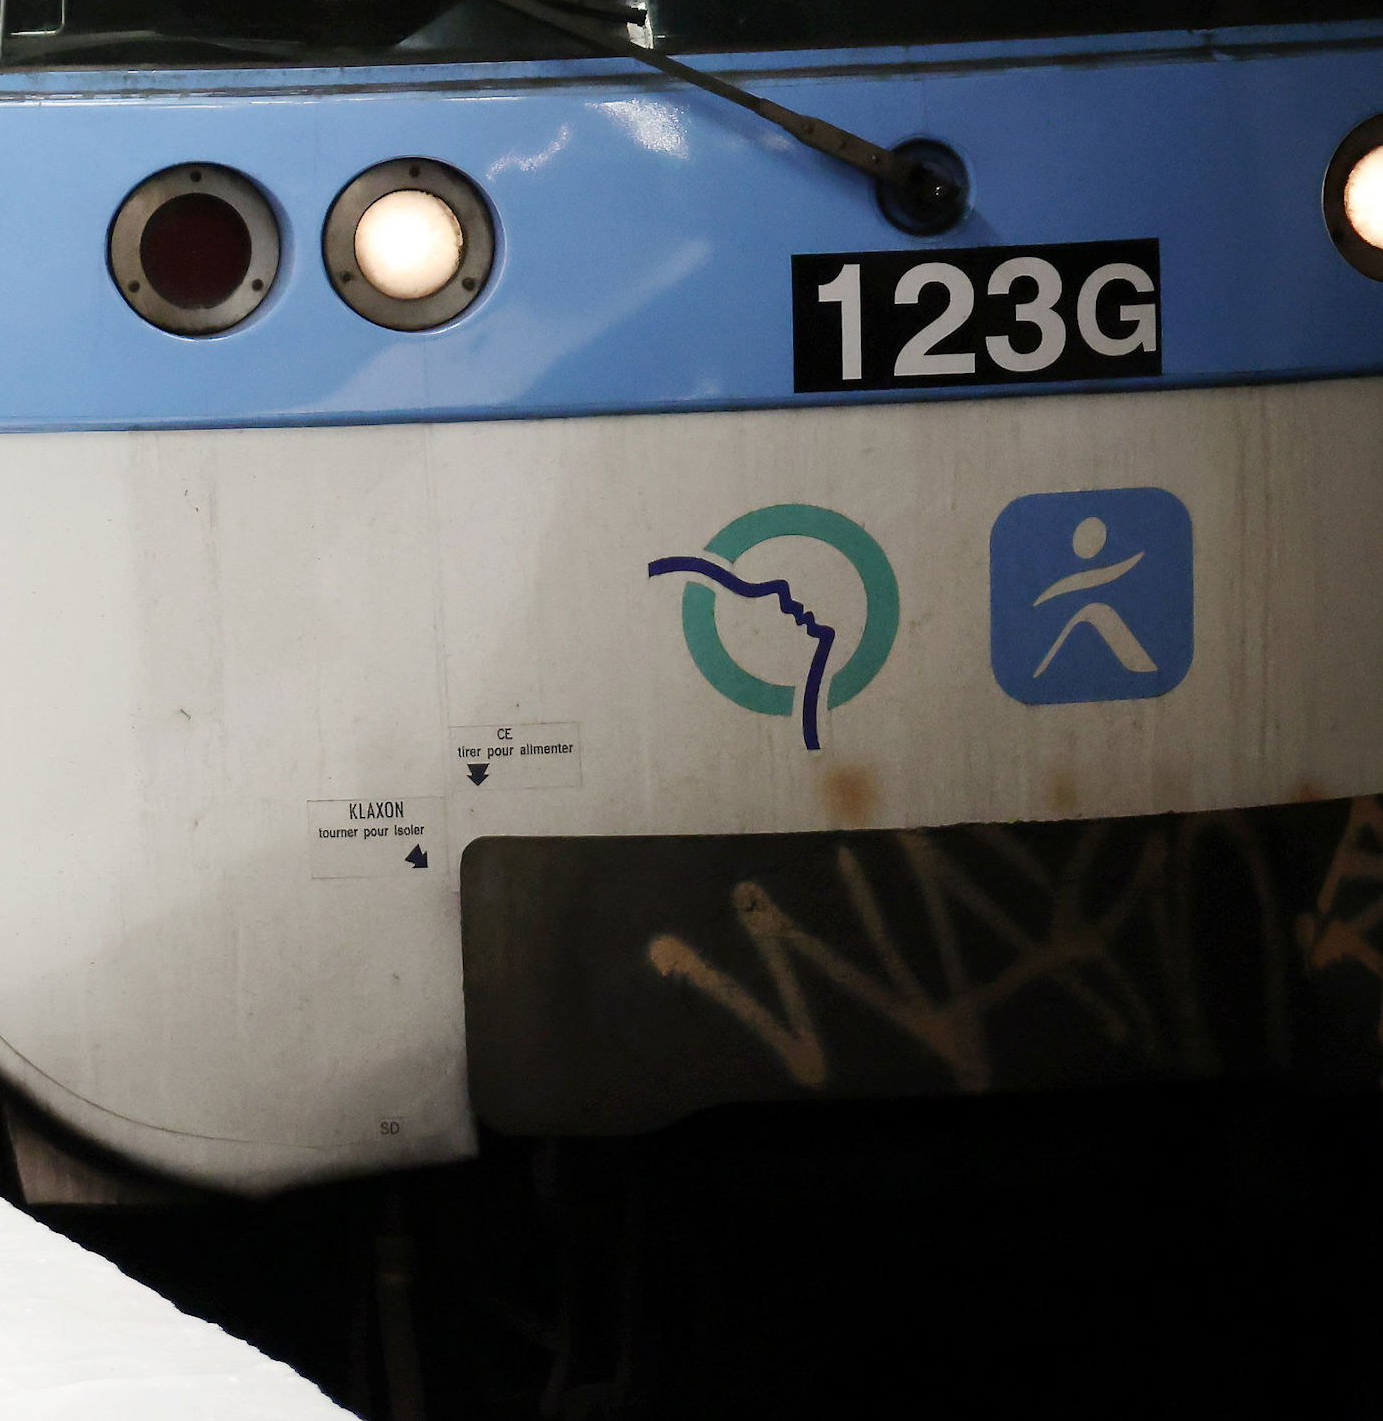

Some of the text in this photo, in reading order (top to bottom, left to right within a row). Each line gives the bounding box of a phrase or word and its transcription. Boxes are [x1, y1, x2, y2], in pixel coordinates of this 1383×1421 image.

[818, 256, 1157, 381] 123G
[496, 728, 514, 741] CE
[457, 743, 574, 759] tirer pour alimenter
[348, 801, 404, 820] KLAXON
[318, 827, 358, 839] tourner
[363, 826, 389, 840] pour
[380, 1121, 400, 1135] SD
